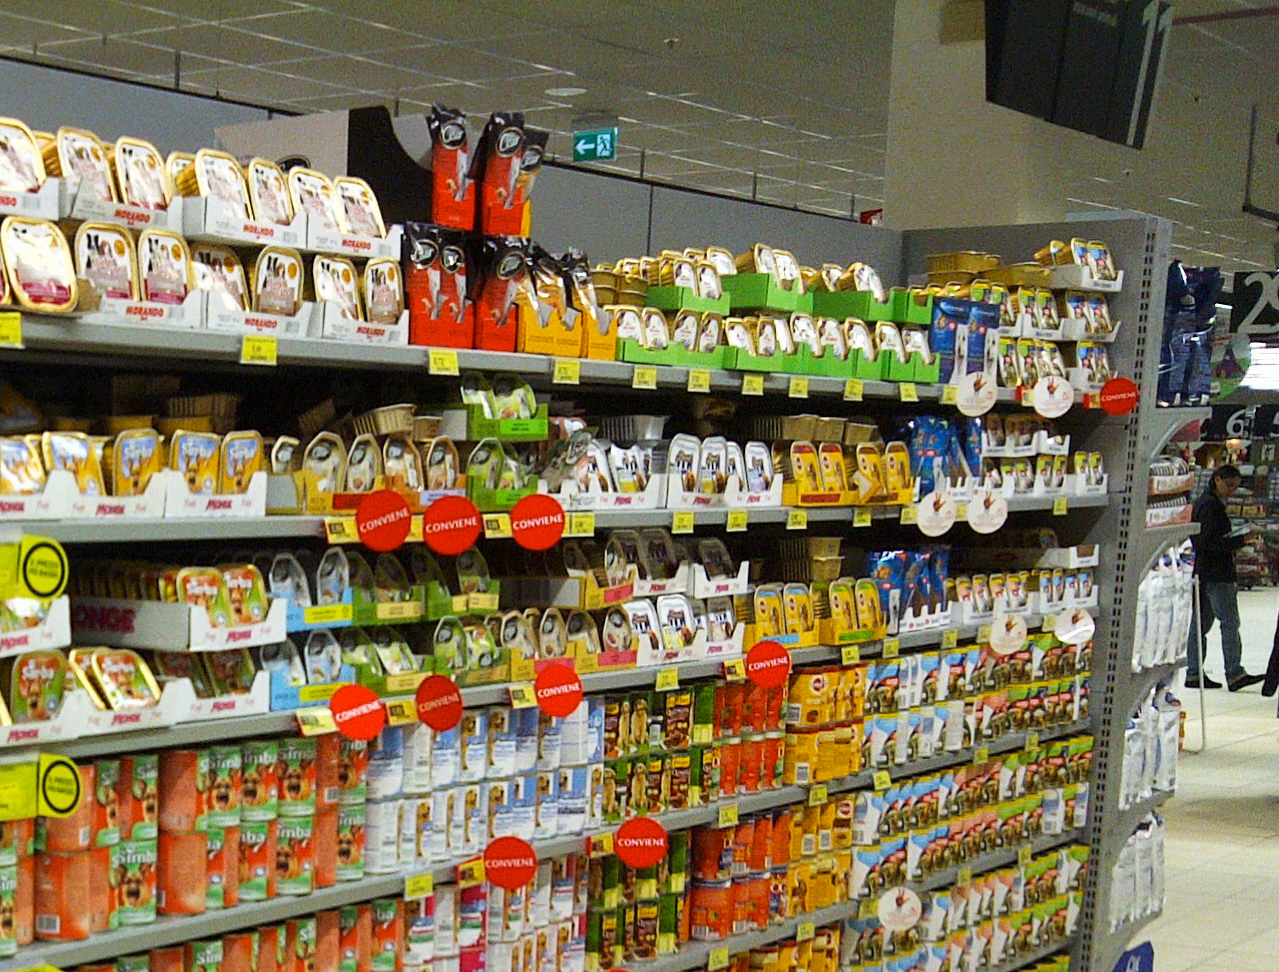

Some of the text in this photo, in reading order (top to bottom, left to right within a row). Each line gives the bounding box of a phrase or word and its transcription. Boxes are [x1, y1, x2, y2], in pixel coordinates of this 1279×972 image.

[359, 506, 411, 533] CONVIENE
[424, 516, 478, 534] CONVIENE
[512, 513, 564, 531] CONVIENE
[748, 655, 789, 671] CONVIENE
[537, 683, 581, 699] CONVIENE
[418, 693, 460, 712] CONVIENE
[335, 701, 382, 723] CONVIENE
[617, 838, 666, 848] CONVIENE
[485, 858, 534, 869] CONVIENE
